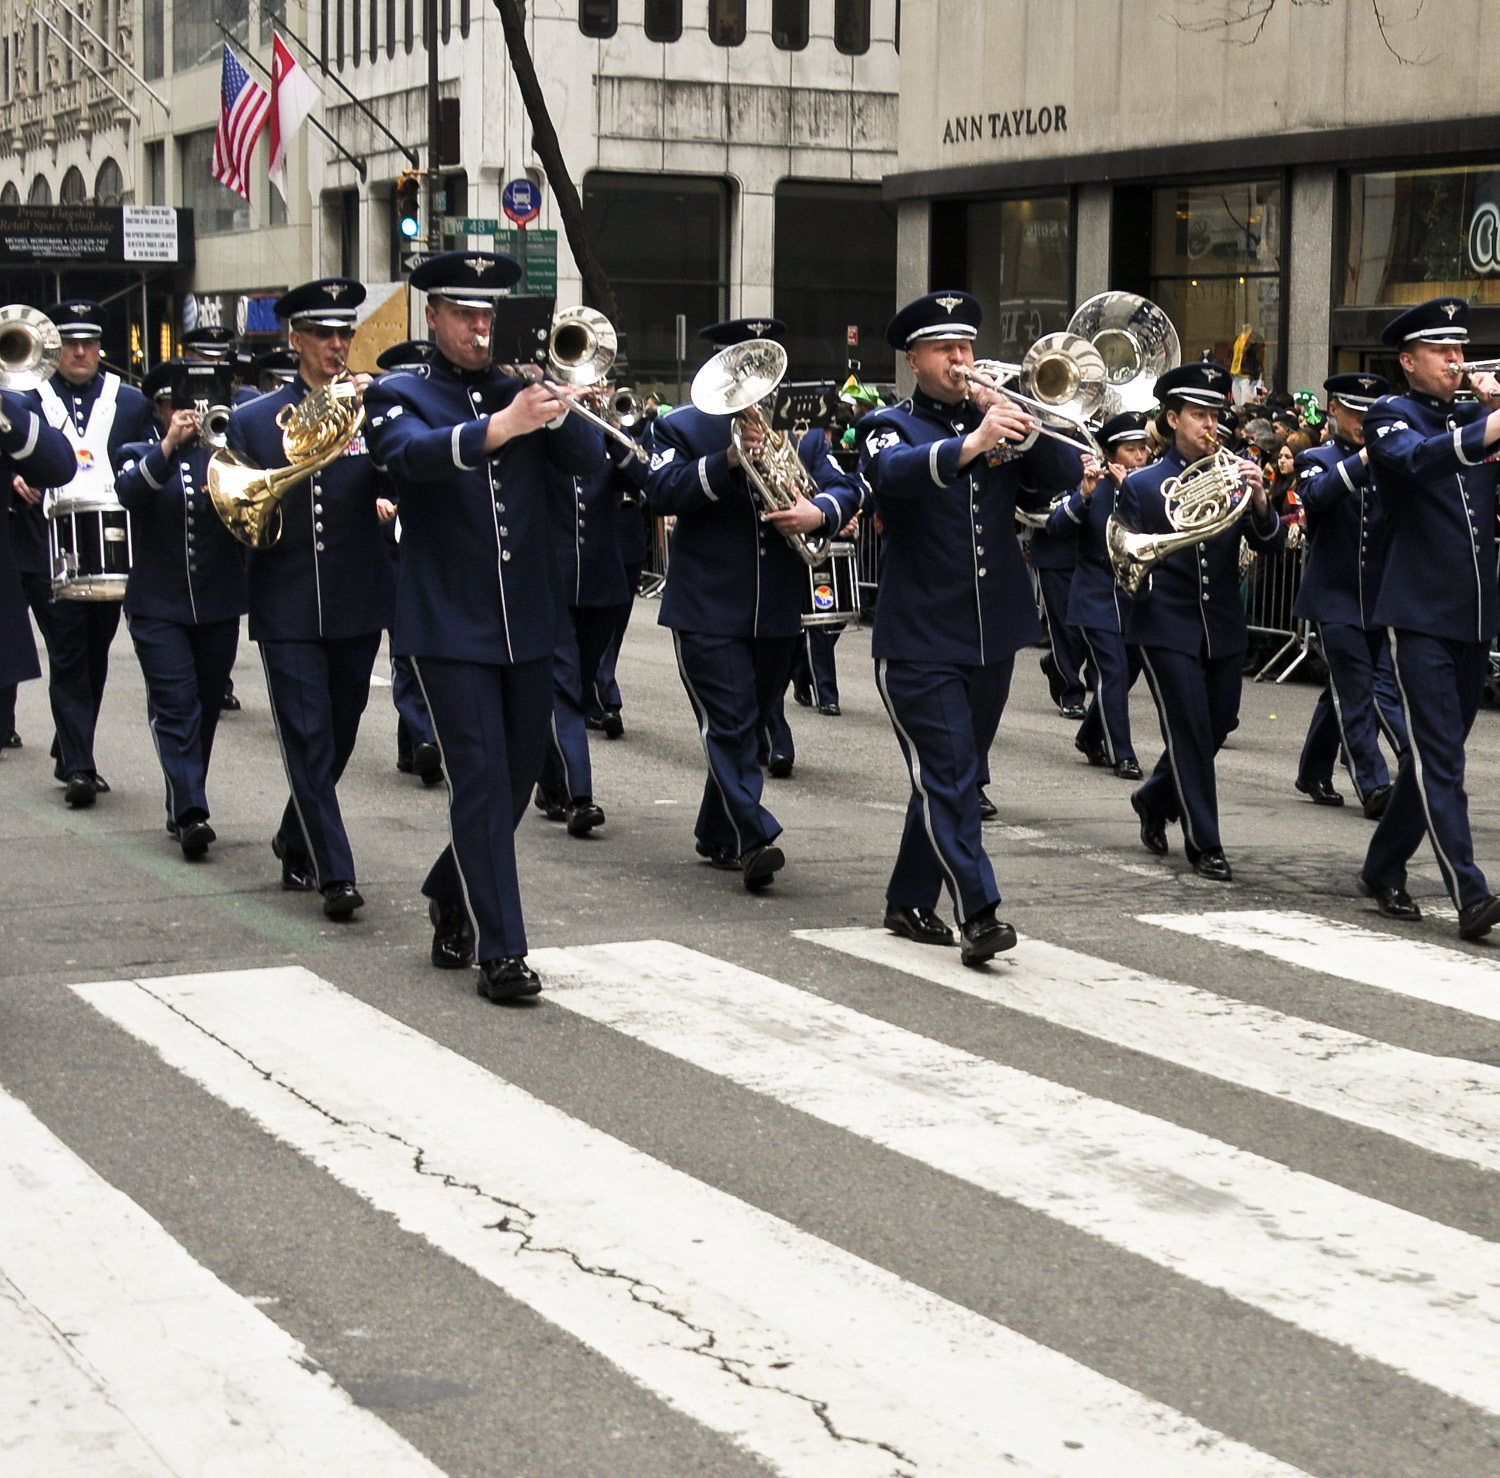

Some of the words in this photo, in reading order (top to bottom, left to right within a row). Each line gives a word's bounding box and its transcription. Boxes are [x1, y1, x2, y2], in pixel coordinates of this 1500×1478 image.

[942, 114, 983, 144] ANN
[988, 105, 1067, 138] TAYLOR
[52, 206, 96, 222] Flagship
[66, 220, 114, 232] Available
[455, 219, 464, 233] W
[470, 220, 485, 233] 48
